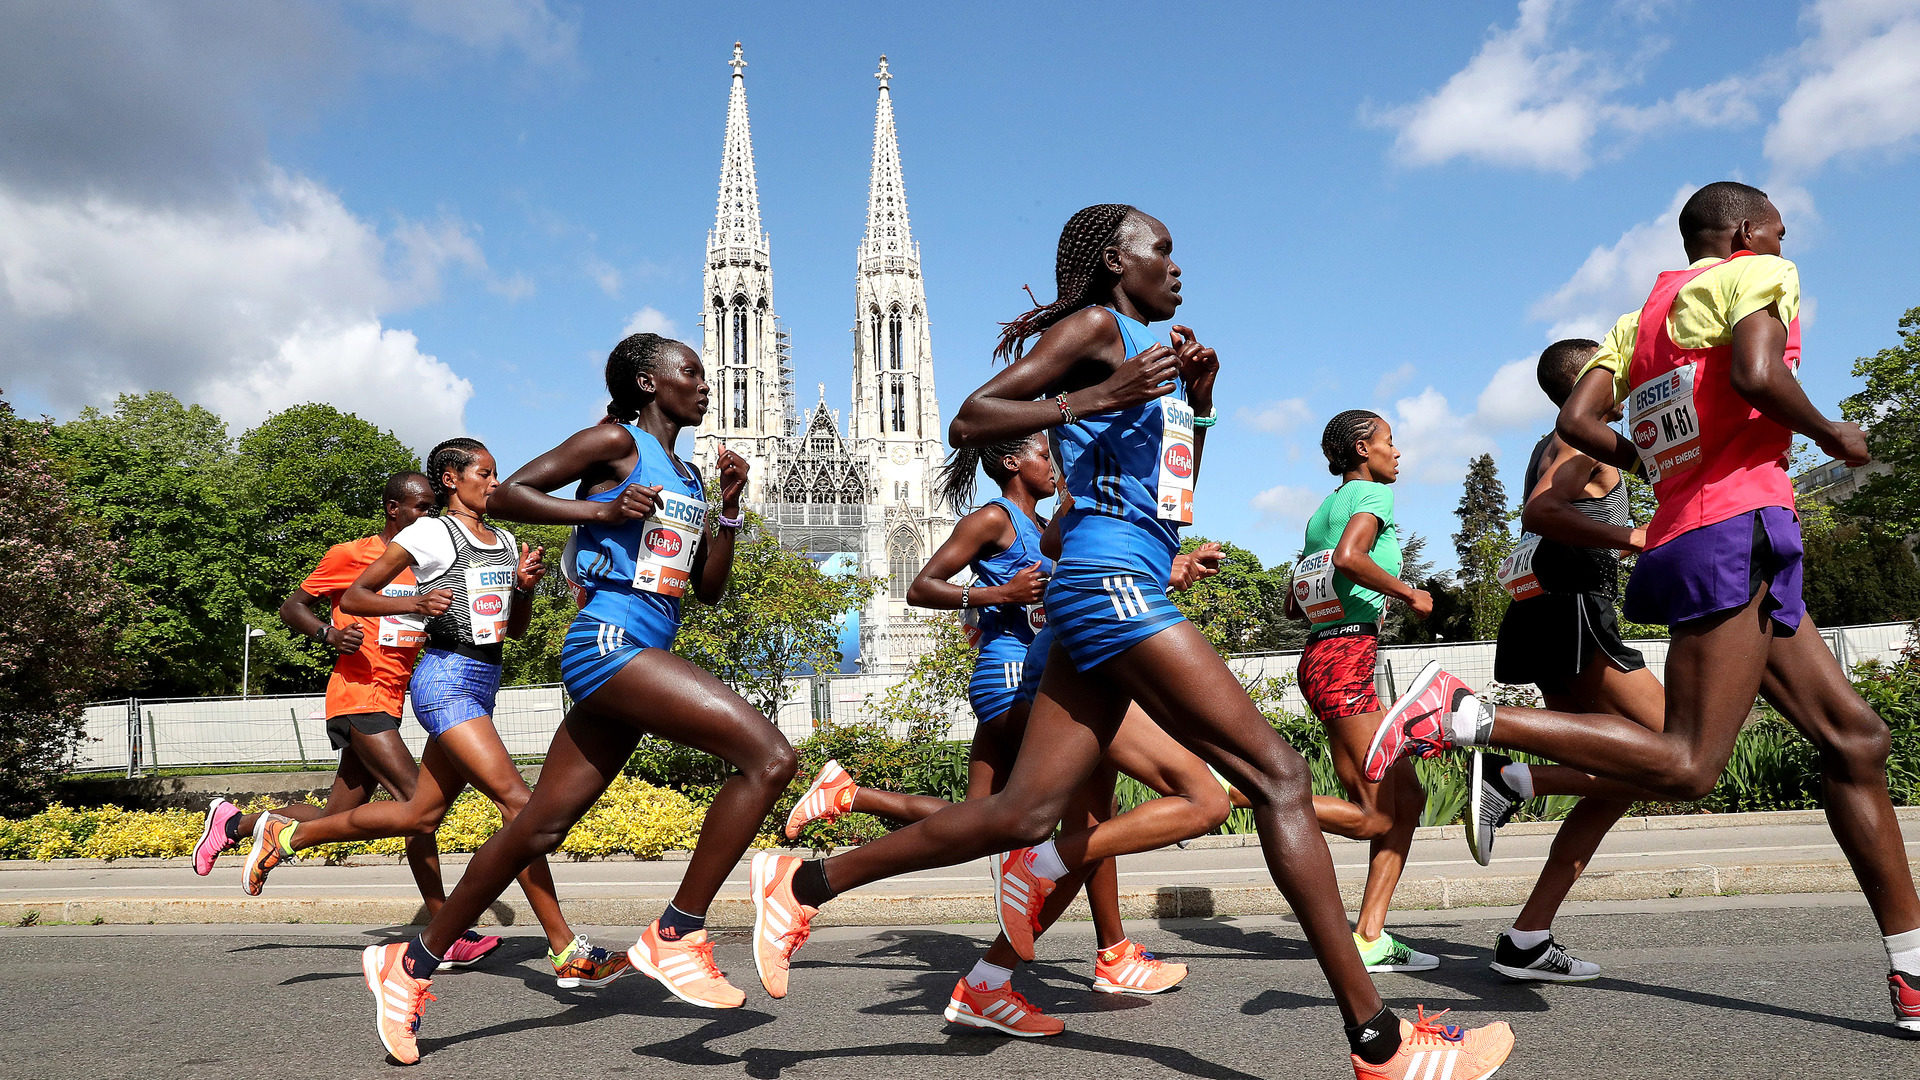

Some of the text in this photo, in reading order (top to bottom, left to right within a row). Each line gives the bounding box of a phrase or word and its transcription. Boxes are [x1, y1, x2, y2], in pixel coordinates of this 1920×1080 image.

[1636, 380, 1670, 412] ERSTE
[1635, 426, 1656, 444] Hervis
[1168, 449, 1192, 471] Hervis
[1660, 446, 1700, 471] WIEN ENERGIE
[665, 498, 704, 526] ERSTE
[648, 532, 680, 553] Hervis
[1301, 555, 1322, 573] ERSTE
[480, 571, 511, 586] ERSTE
[661, 576, 680, 588] WIEN
[1315, 577, 1327, 599] F-8
[475, 599, 502, 611] Hervis
[1318, 605, 1342, 617] ENERGIE
[1318, 624, 1360, 638] NIKE PRO
